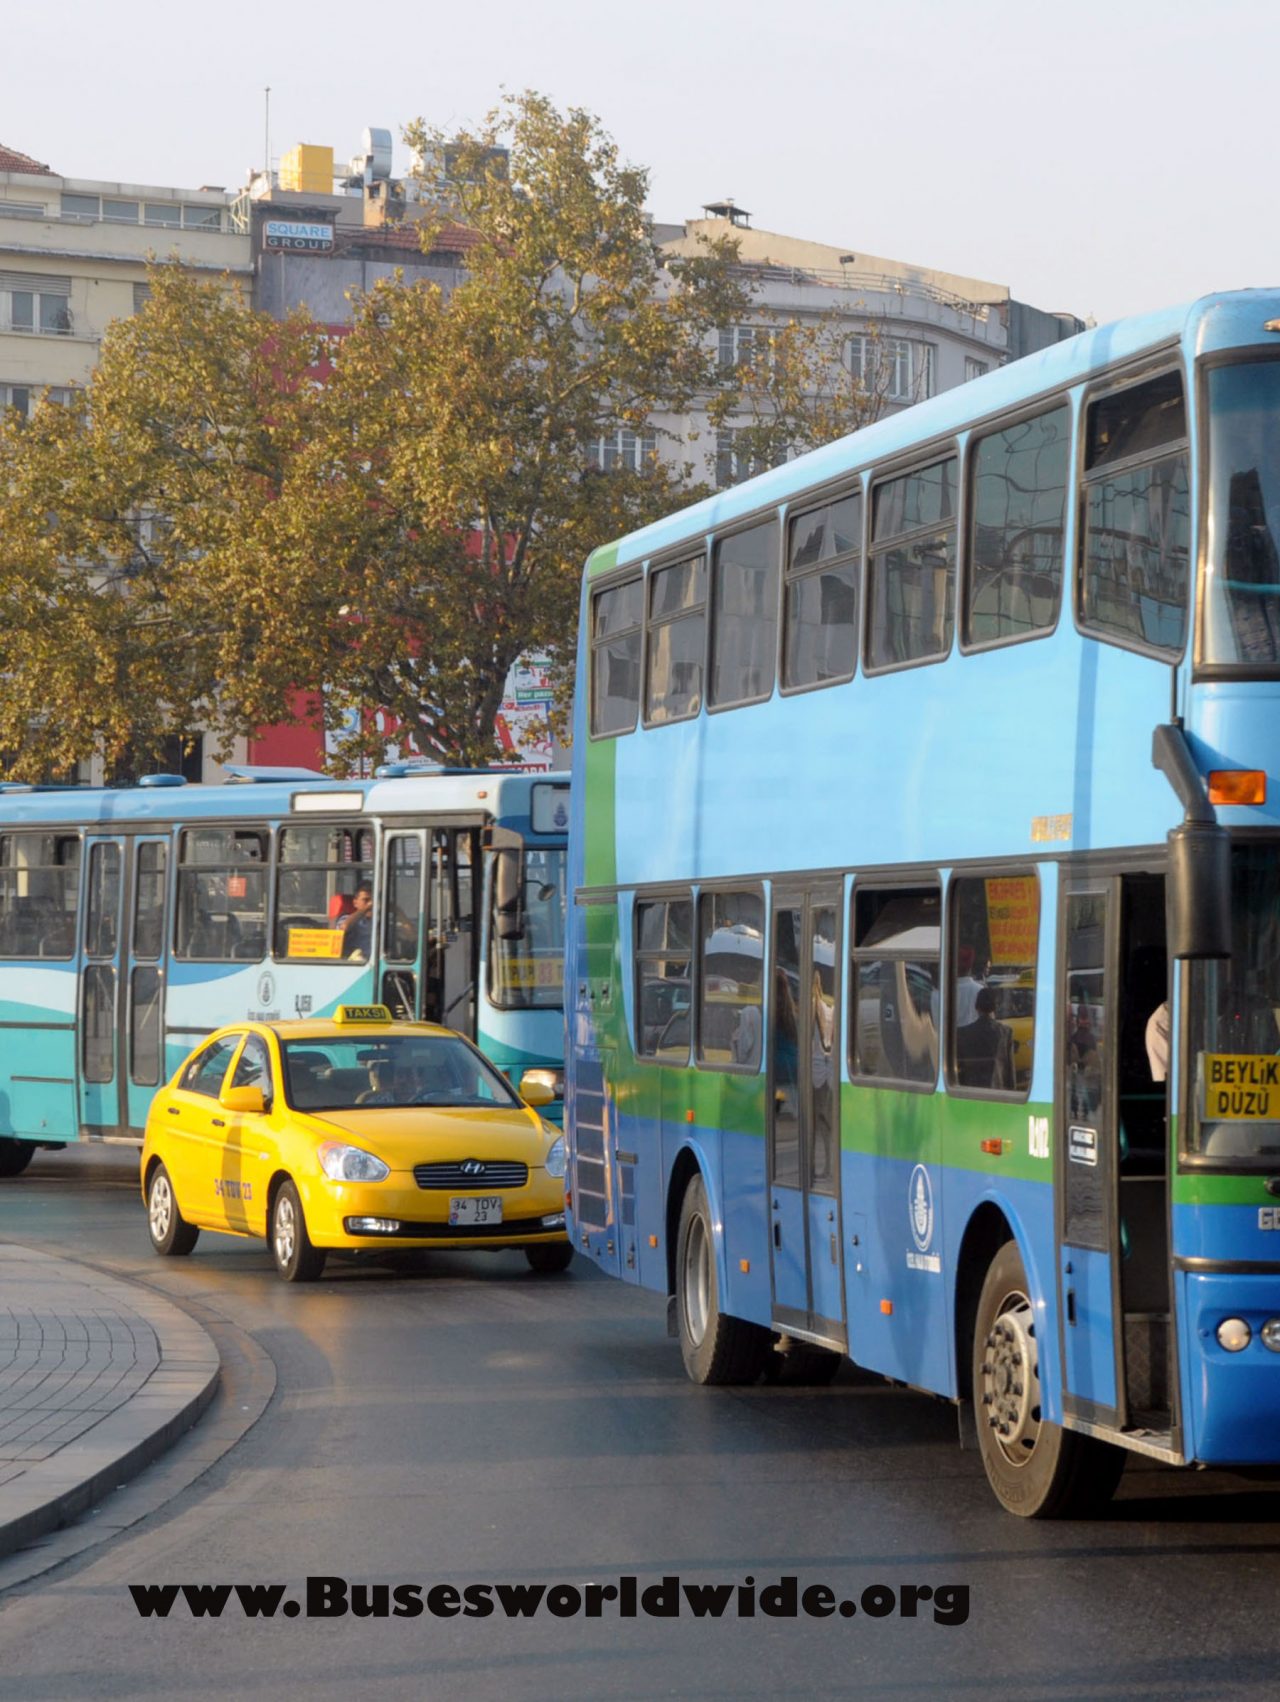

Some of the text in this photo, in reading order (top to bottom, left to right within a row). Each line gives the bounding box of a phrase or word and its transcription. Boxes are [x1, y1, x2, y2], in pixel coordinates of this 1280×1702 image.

[267, 223, 330, 238] SQUARE
[267, 237, 331, 249] GROUP
[1218, 1086, 1270, 1115] DÜZÜ
[454, 1199, 497, 1210] 34 TDV
[474, 1211, 488, 1221] 23
